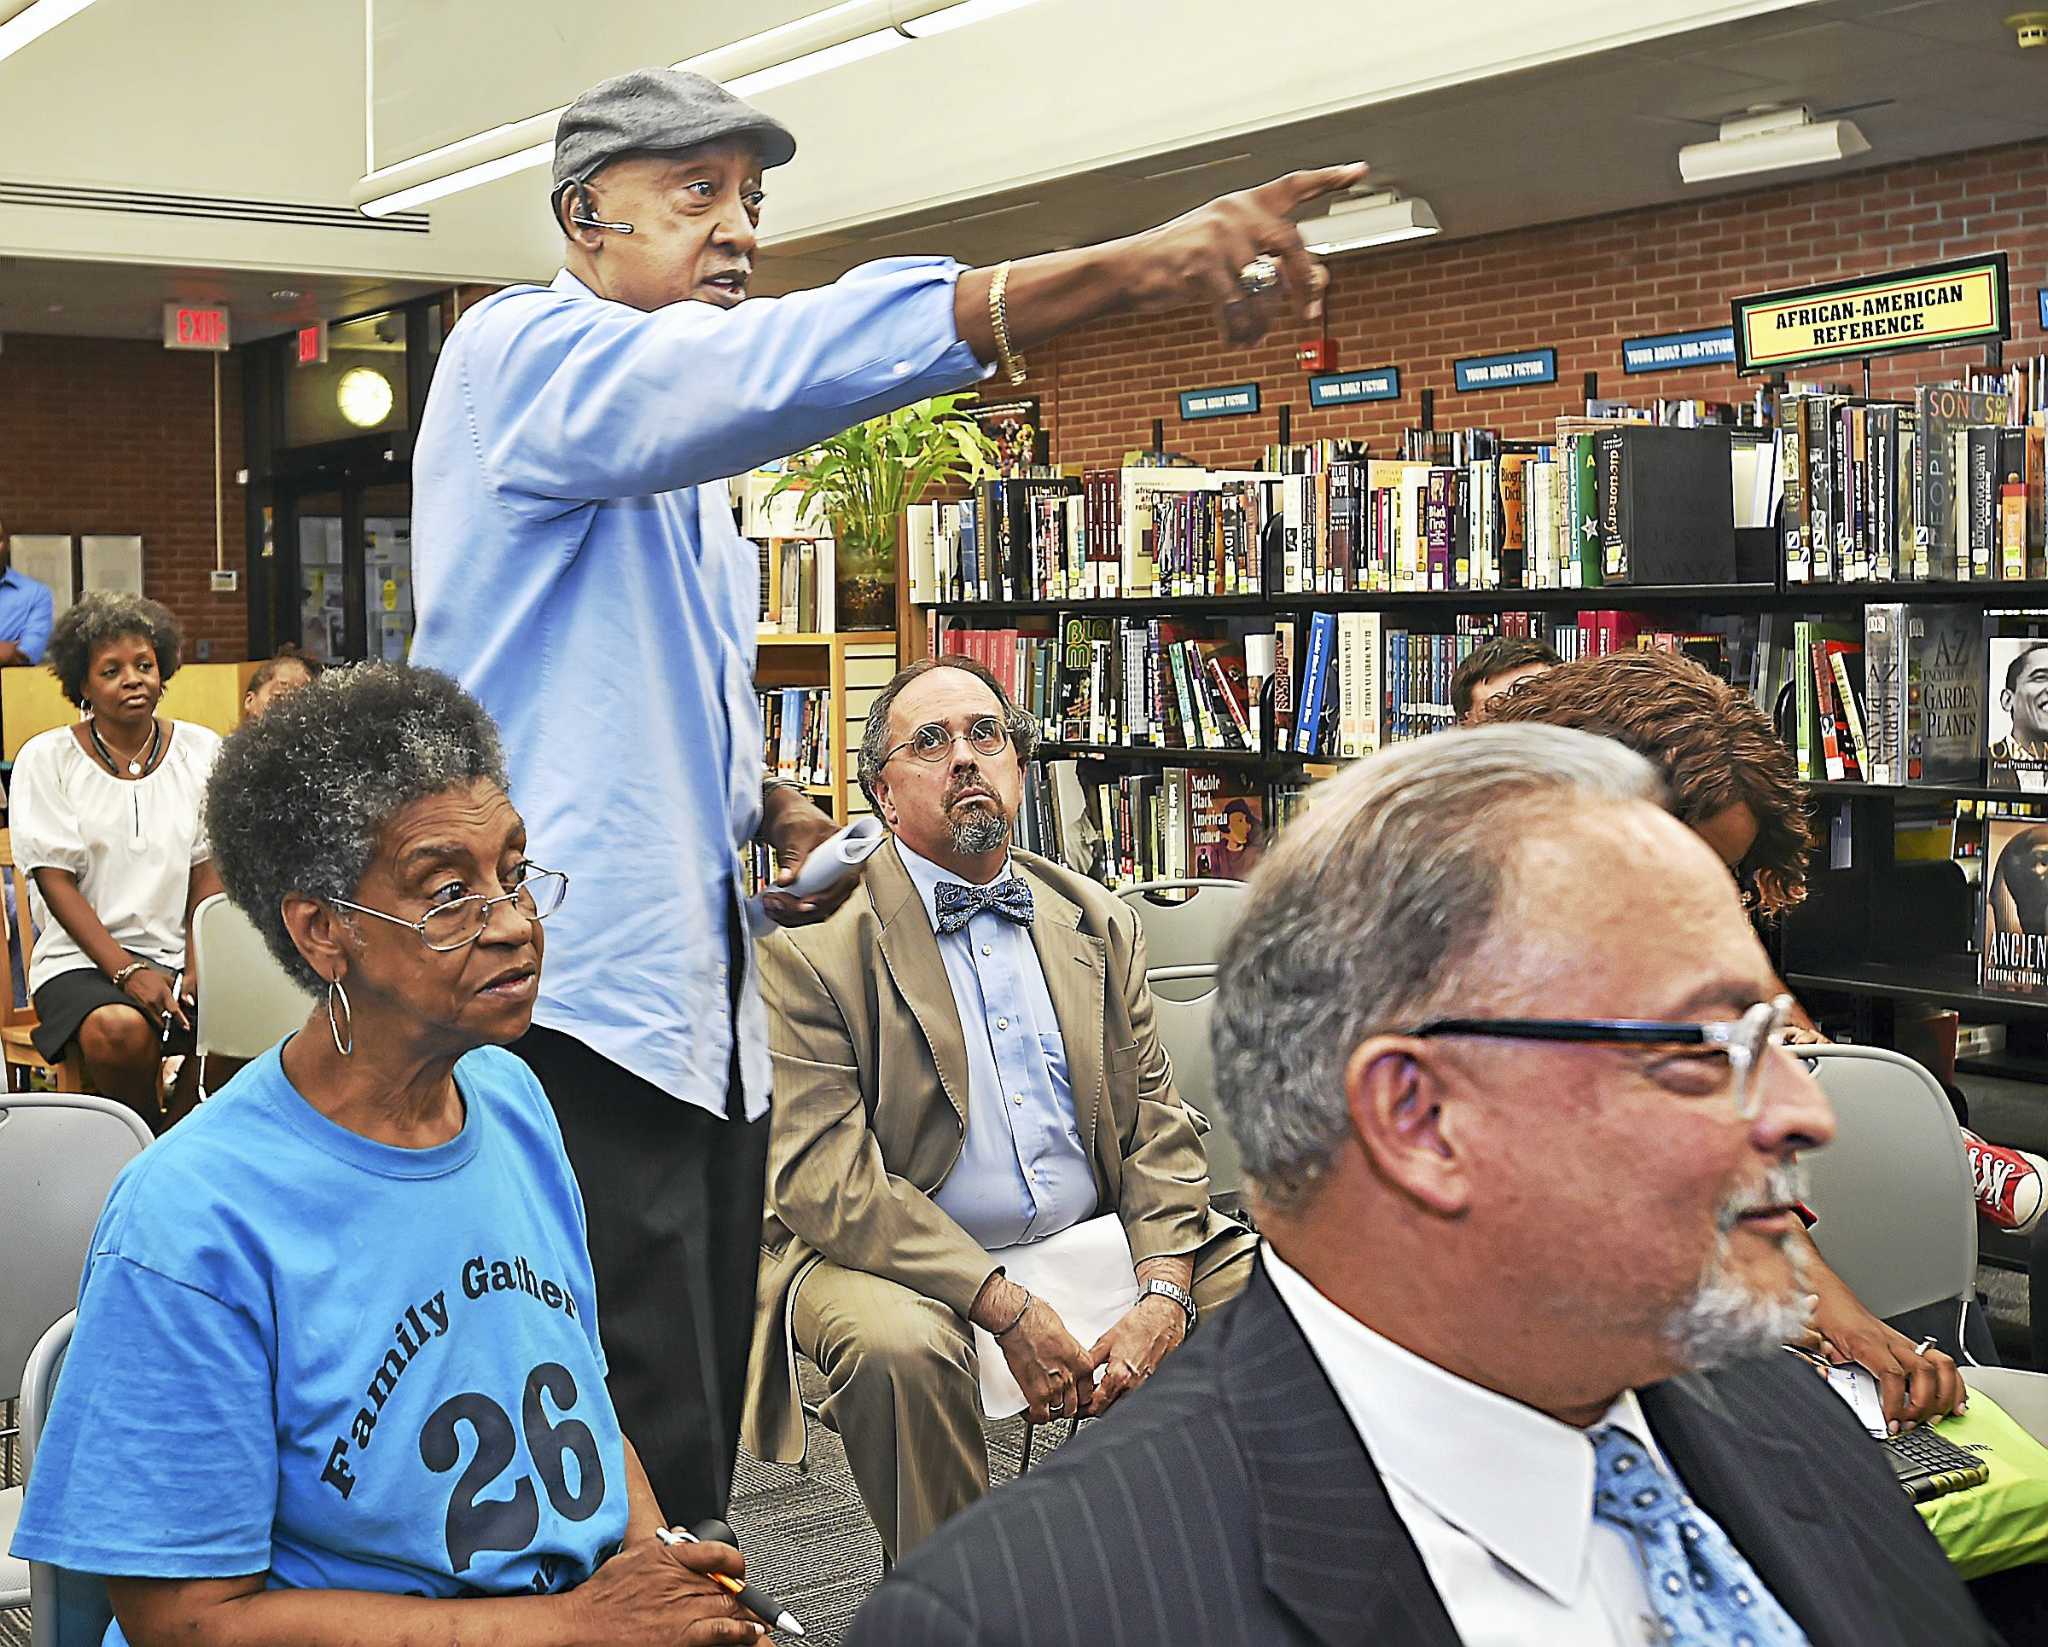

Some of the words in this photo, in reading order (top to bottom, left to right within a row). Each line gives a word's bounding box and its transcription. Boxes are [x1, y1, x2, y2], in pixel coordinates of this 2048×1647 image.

[1775, 284, 1963, 330] AFRICAN-AMERICAN
[177, 309, 222, 344] EXIT
[1813, 313, 1925, 346] REFERENCE
[1513, 360, 1544, 377] FICTION
[1929, 390, 1994, 424] SONGS
[1924, 683, 1978, 711] GARDEN
[1926, 711, 1977, 738] PLANTS
[2008, 759, 2043, 771] Promise
[1191, 774, 1220, 791] Notable
[1191, 791, 1213, 809] Black
[1192, 811, 1228, 828] American
[1192, 828, 1221, 845] Women
[1987, 929, 2047, 969] ANCIEN
[1987, 967, 2015, 984] GENERAL
[320, 1290, 449, 1501] Family
[461, 1255, 577, 1320] Gather
[418, 1361, 606, 1574] 26
